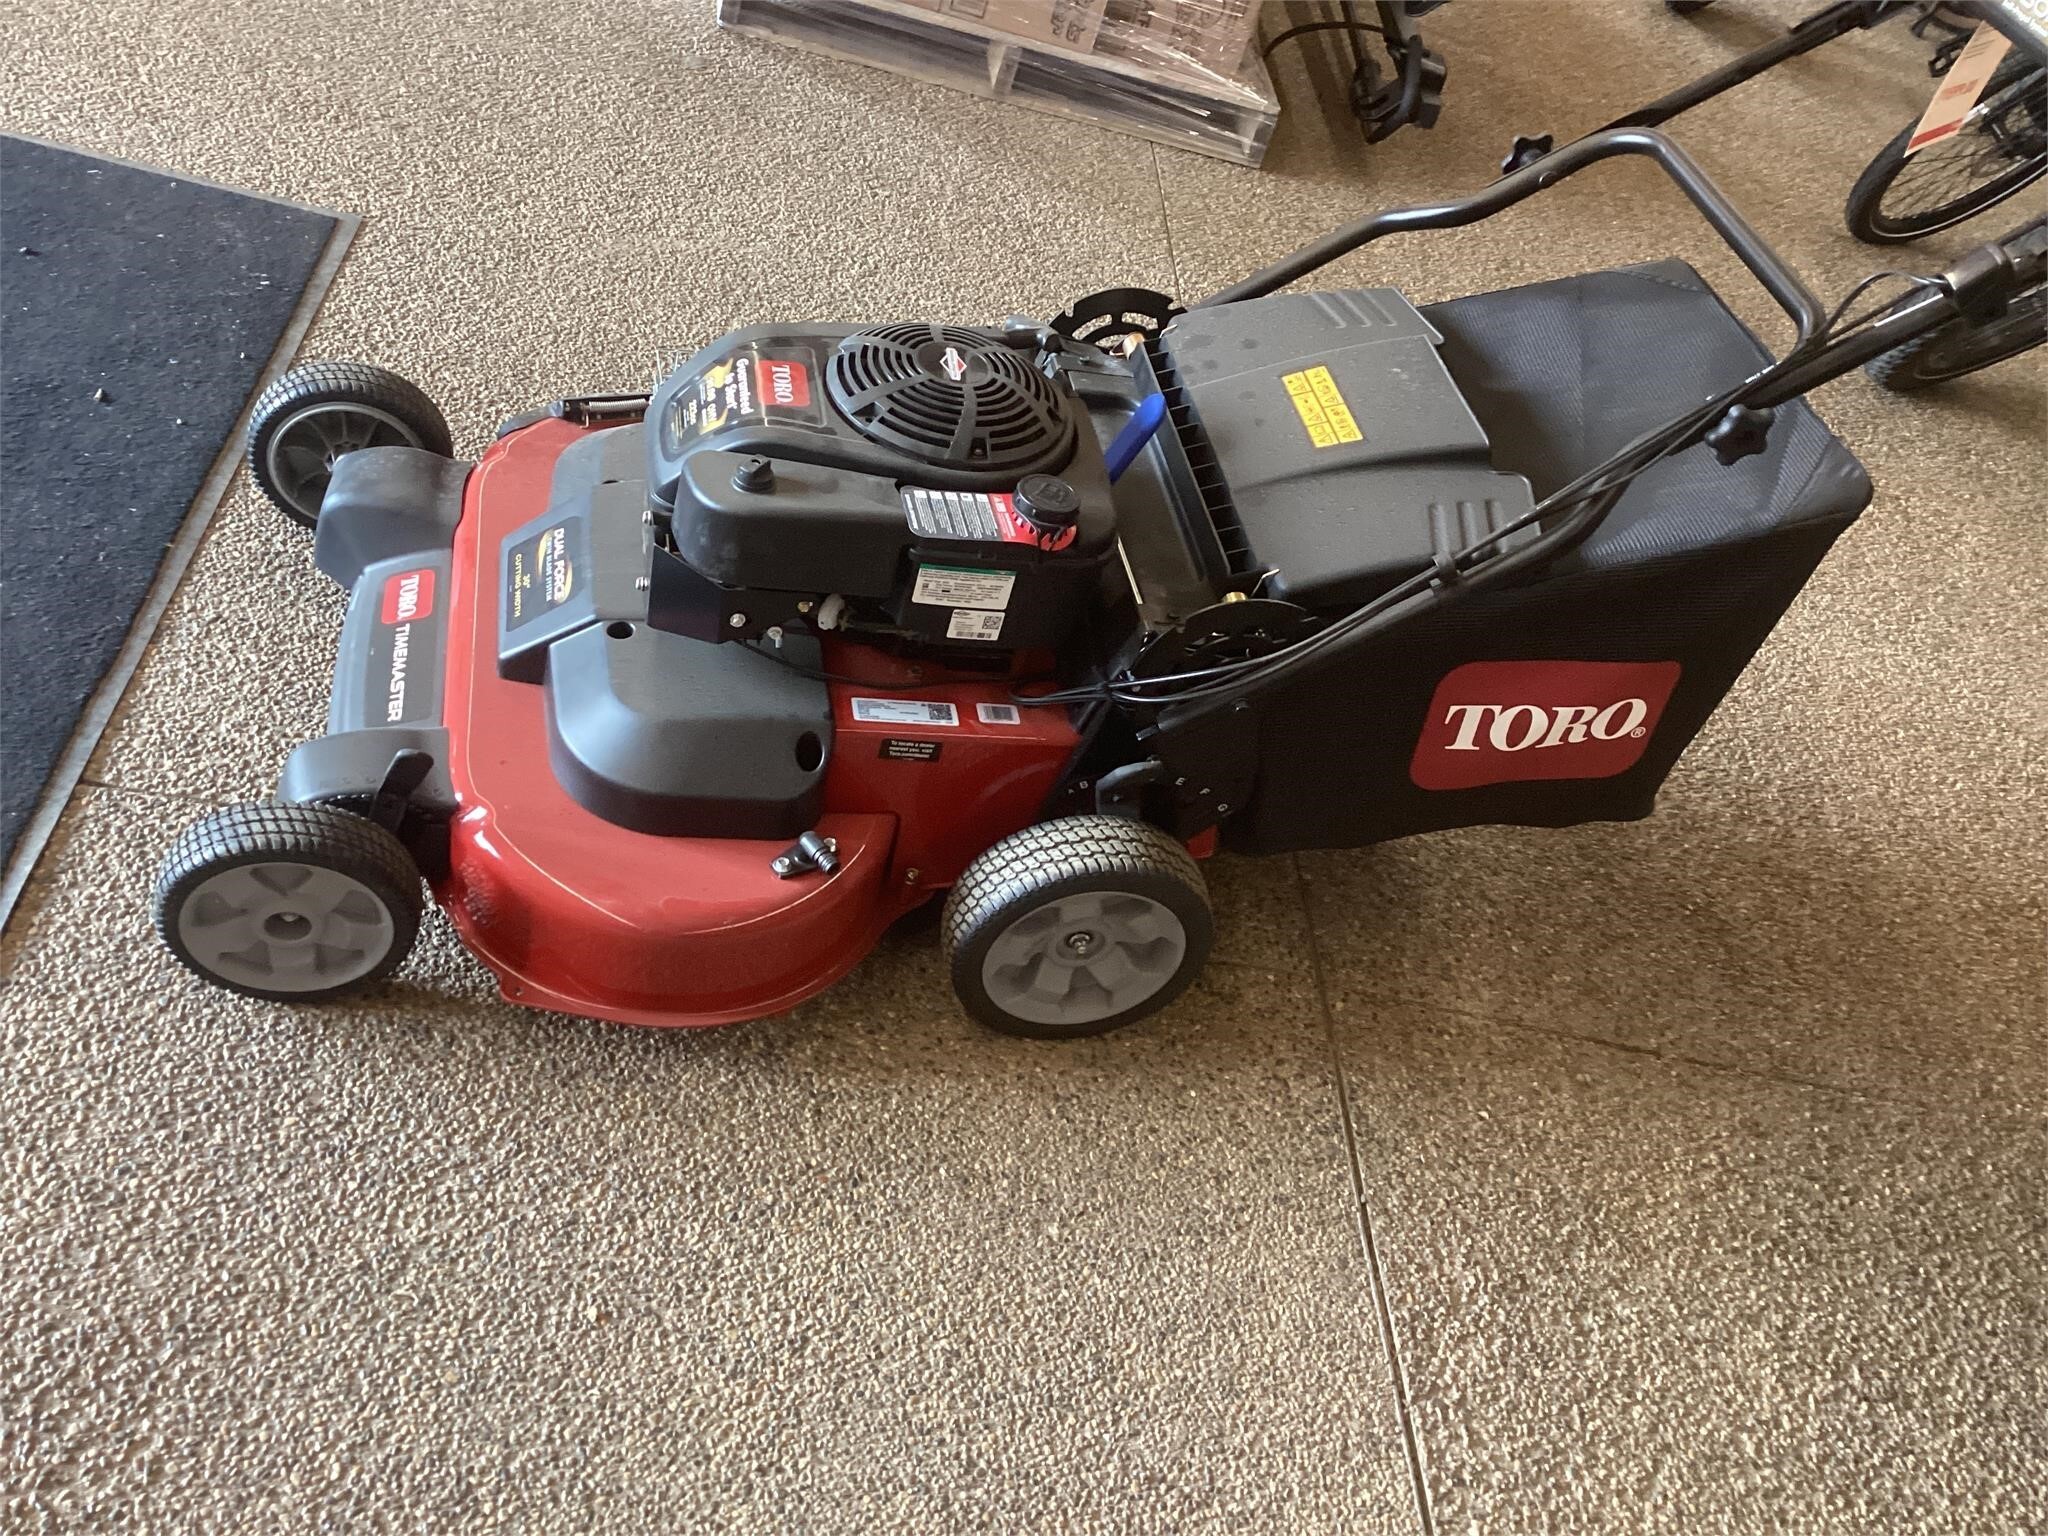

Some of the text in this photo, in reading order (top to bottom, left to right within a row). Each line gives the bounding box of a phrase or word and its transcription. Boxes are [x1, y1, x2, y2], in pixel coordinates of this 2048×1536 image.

[736, 358, 754, 415] Guaranteed
[771, 364, 794, 403] TORO
[553, 527, 565, 601] DUAL FORCE
[514, 553, 523, 618] CUTTING WIDTH
[387, 622, 411, 722] TIMEMASTER
[1079, 780, 1089, 789] B
[1175, 776, 1186, 787] E
[1199, 787, 1211, 796] F
[1217, 803, 1229, 813] G
